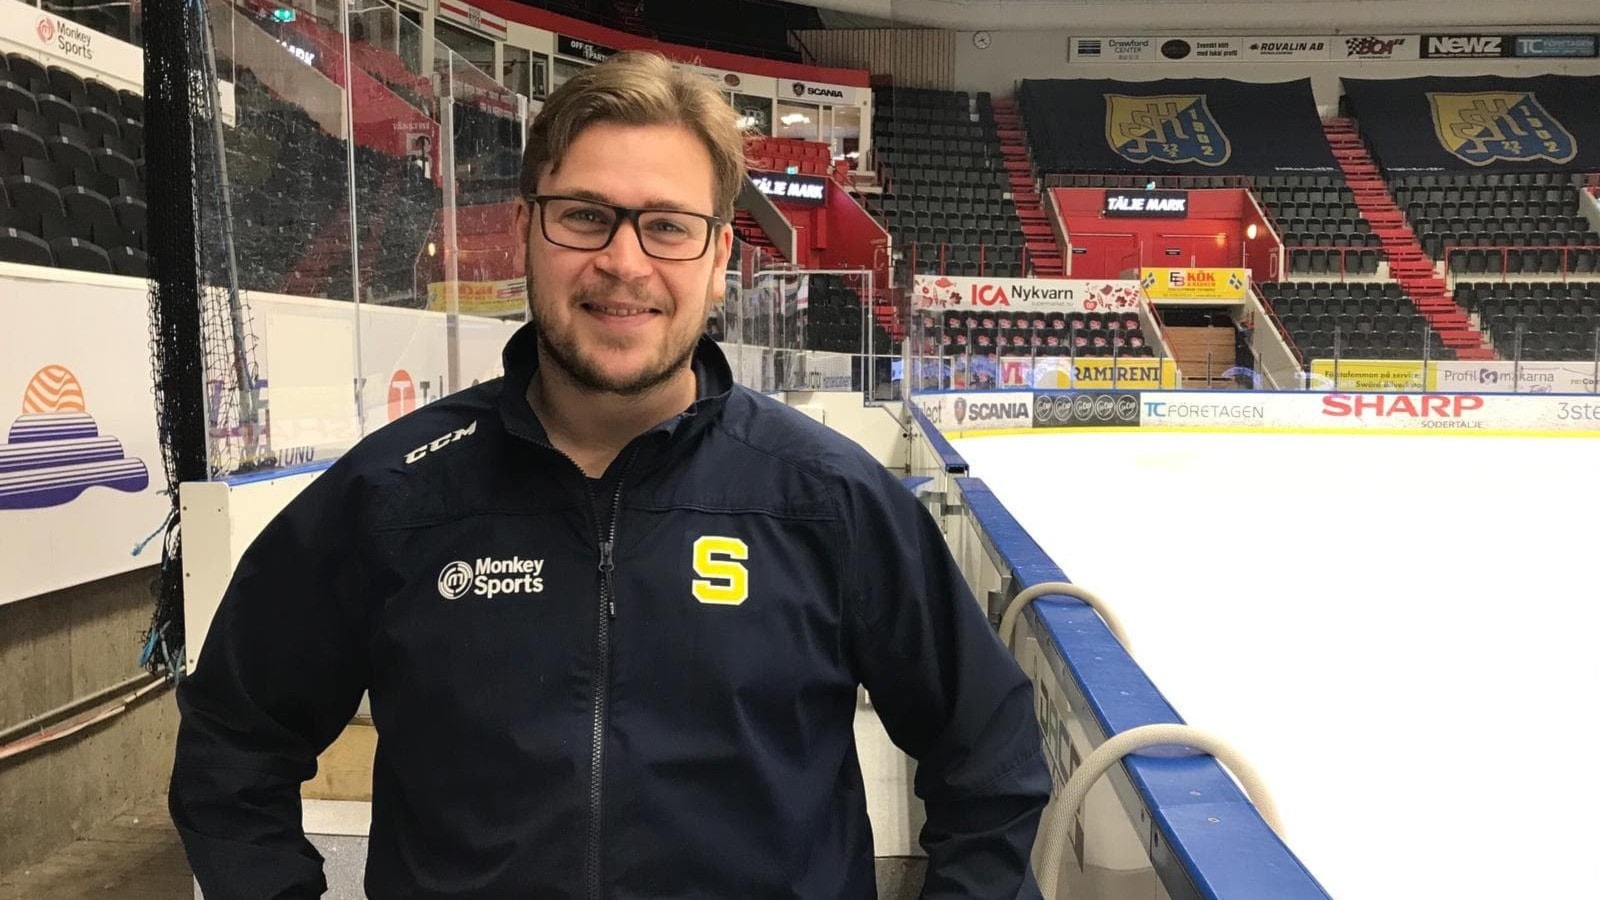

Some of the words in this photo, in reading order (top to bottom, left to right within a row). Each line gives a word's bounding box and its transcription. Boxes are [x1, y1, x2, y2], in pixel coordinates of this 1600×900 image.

[57, 21, 91, 46] Monkey
[58, 35, 93, 60] Sports
[1260, 42, 1307, 51] ROVALIN
[1309, 42, 1325, 51] AB
[1518, 39, 1543, 54] TC
[808, 87, 844, 99] SCANIA
[787, 183, 824, 199] MARK
[1146, 198, 1186, 211] MARK
[1187, 270, 1216, 282] KÖK
[971, 284, 1011, 306] ICA
[1011, 285, 1074, 301] Nykvarn
[1444, 369, 1477, 382] Profil
[968, 402, 1030, 421] SCANIA
[1321, 394, 1484, 418] SHARP
[403, 420, 477, 464] CCM
[475, 556, 544, 577] Monkey
[692, 535, 749, 605] S
[474, 574, 544, 598] Sports
